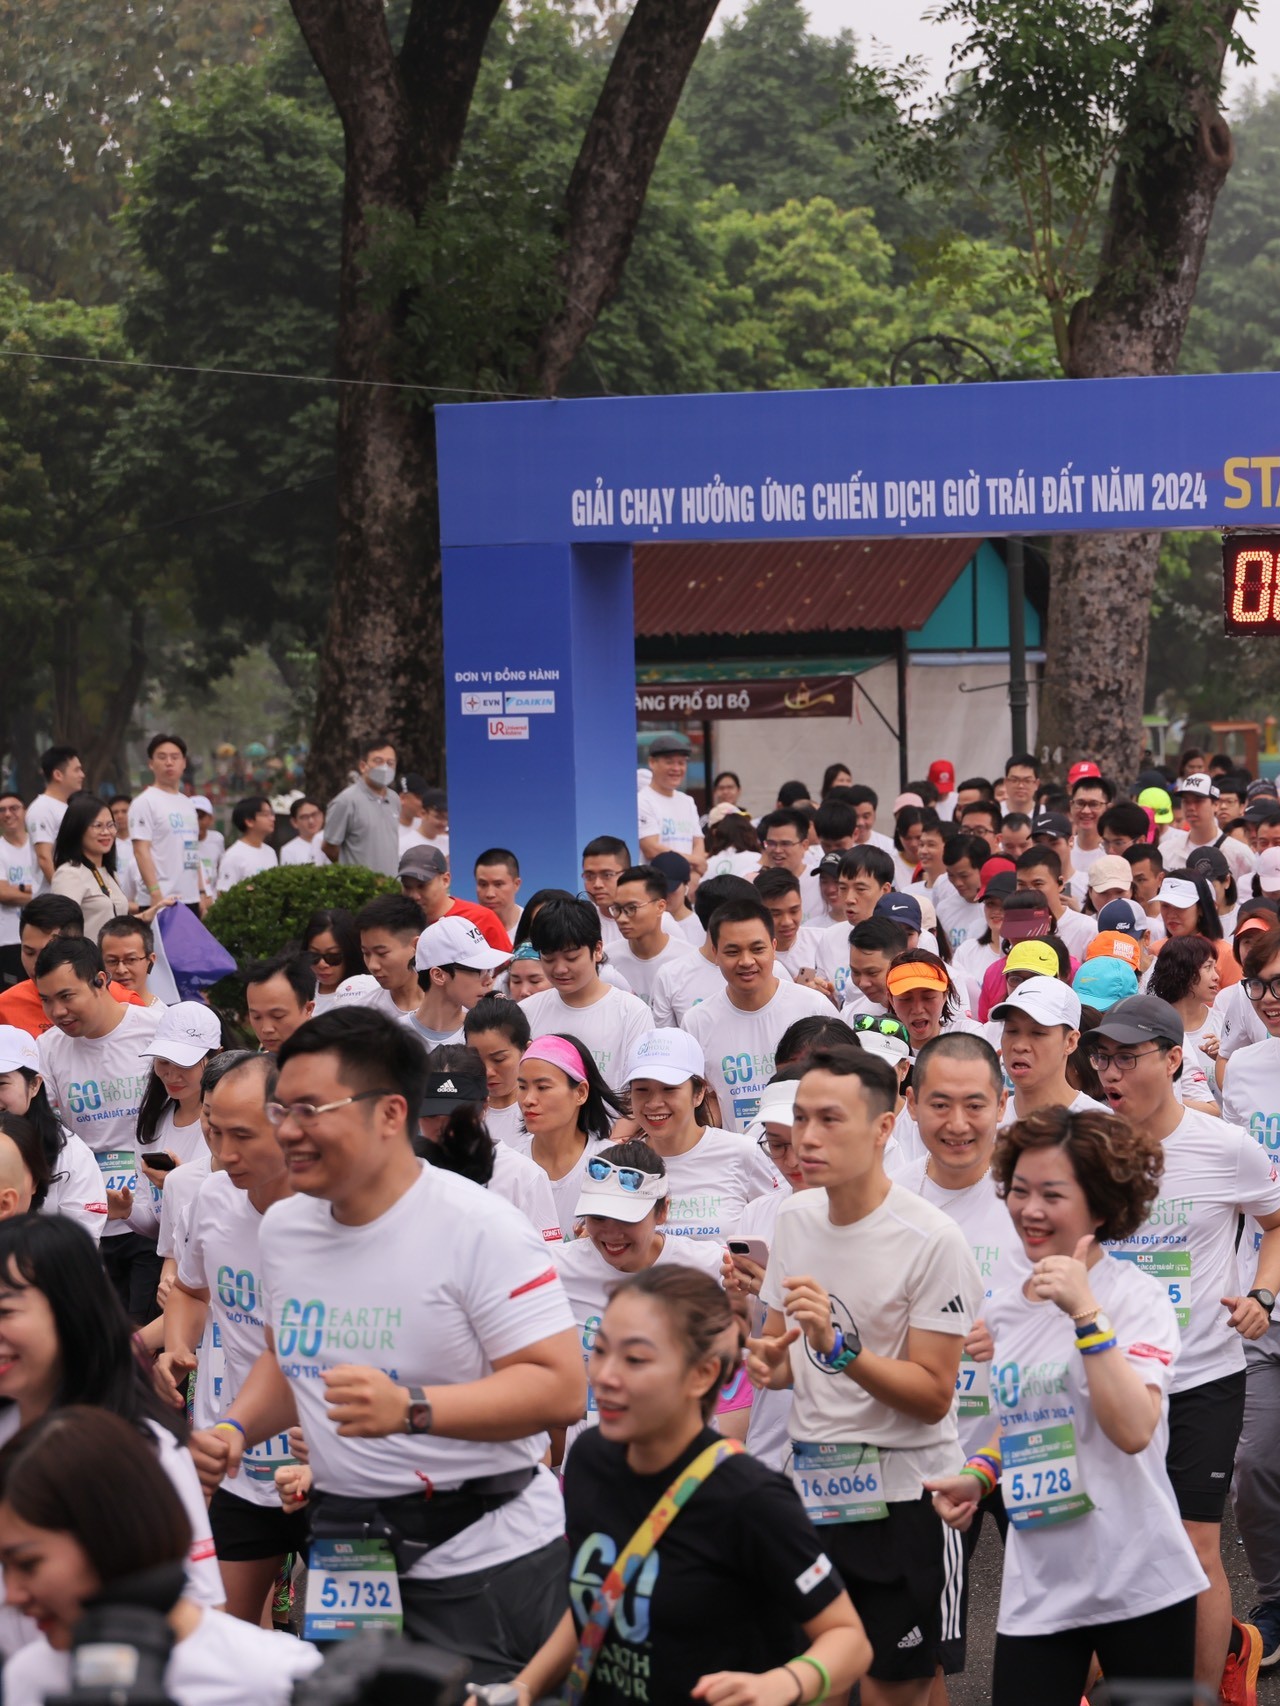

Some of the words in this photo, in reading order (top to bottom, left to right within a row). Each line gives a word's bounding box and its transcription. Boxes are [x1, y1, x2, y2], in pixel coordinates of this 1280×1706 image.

[572, 477, 614, 526] GIẢI
[620, 488, 675, 533] CHẠY
[681, 474, 755, 524] HƯỞNG
[761, 477, 806, 522] ỨNG
[812, 470, 878, 520] CHIẾN
[884, 480, 936, 527] DỊCH
[943, 469, 980, 517] GIỜ
[986, 469, 1036, 515] TRÁI
[1042, 462, 1085, 514] ĐẤT
[1091, 466, 1144, 513] NĂM
[1151, 472, 1207, 511] 2024
[455, 671, 479, 682] ĐƠN
[481, 672, 492, 684] VỊ
[494, 667, 526, 681] ĐỒNG
[529, 668, 559, 680] HÀNH
[515, 698, 553, 706] DAIKIN
[669, 688, 704, 710] PHỐ
[705, 694, 723, 709] ĐI
[727, 689, 750, 711] BỘ
[722, 1052, 753, 1085] 60
[101, 1075, 146, 1092] EARTH
[68, 1080, 101, 1114] 60
[103, 1088, 143, 1103] HOUR
[669, 1196, 721, 1209] EARTH
[669, 1208, 719, 1220] HOUR
[697, 1227, 720, 1236] 2024
[1162, 1235, 1187, 1244] 2024
[217, 1265, 255, 1313] 60
[278, 1298, 325, 1357] 60
[328, 1307, 402, 1328] EARTH
[326, 1329, 395, 1350] HOUR
[1022, 1378, 1068, 1399] HOUR
[801, 1473, 877, 1497] 16.6066
[1012, 1467, 1072, 1501] 5.728
[321, 1577, 392, 1607] 5.732
